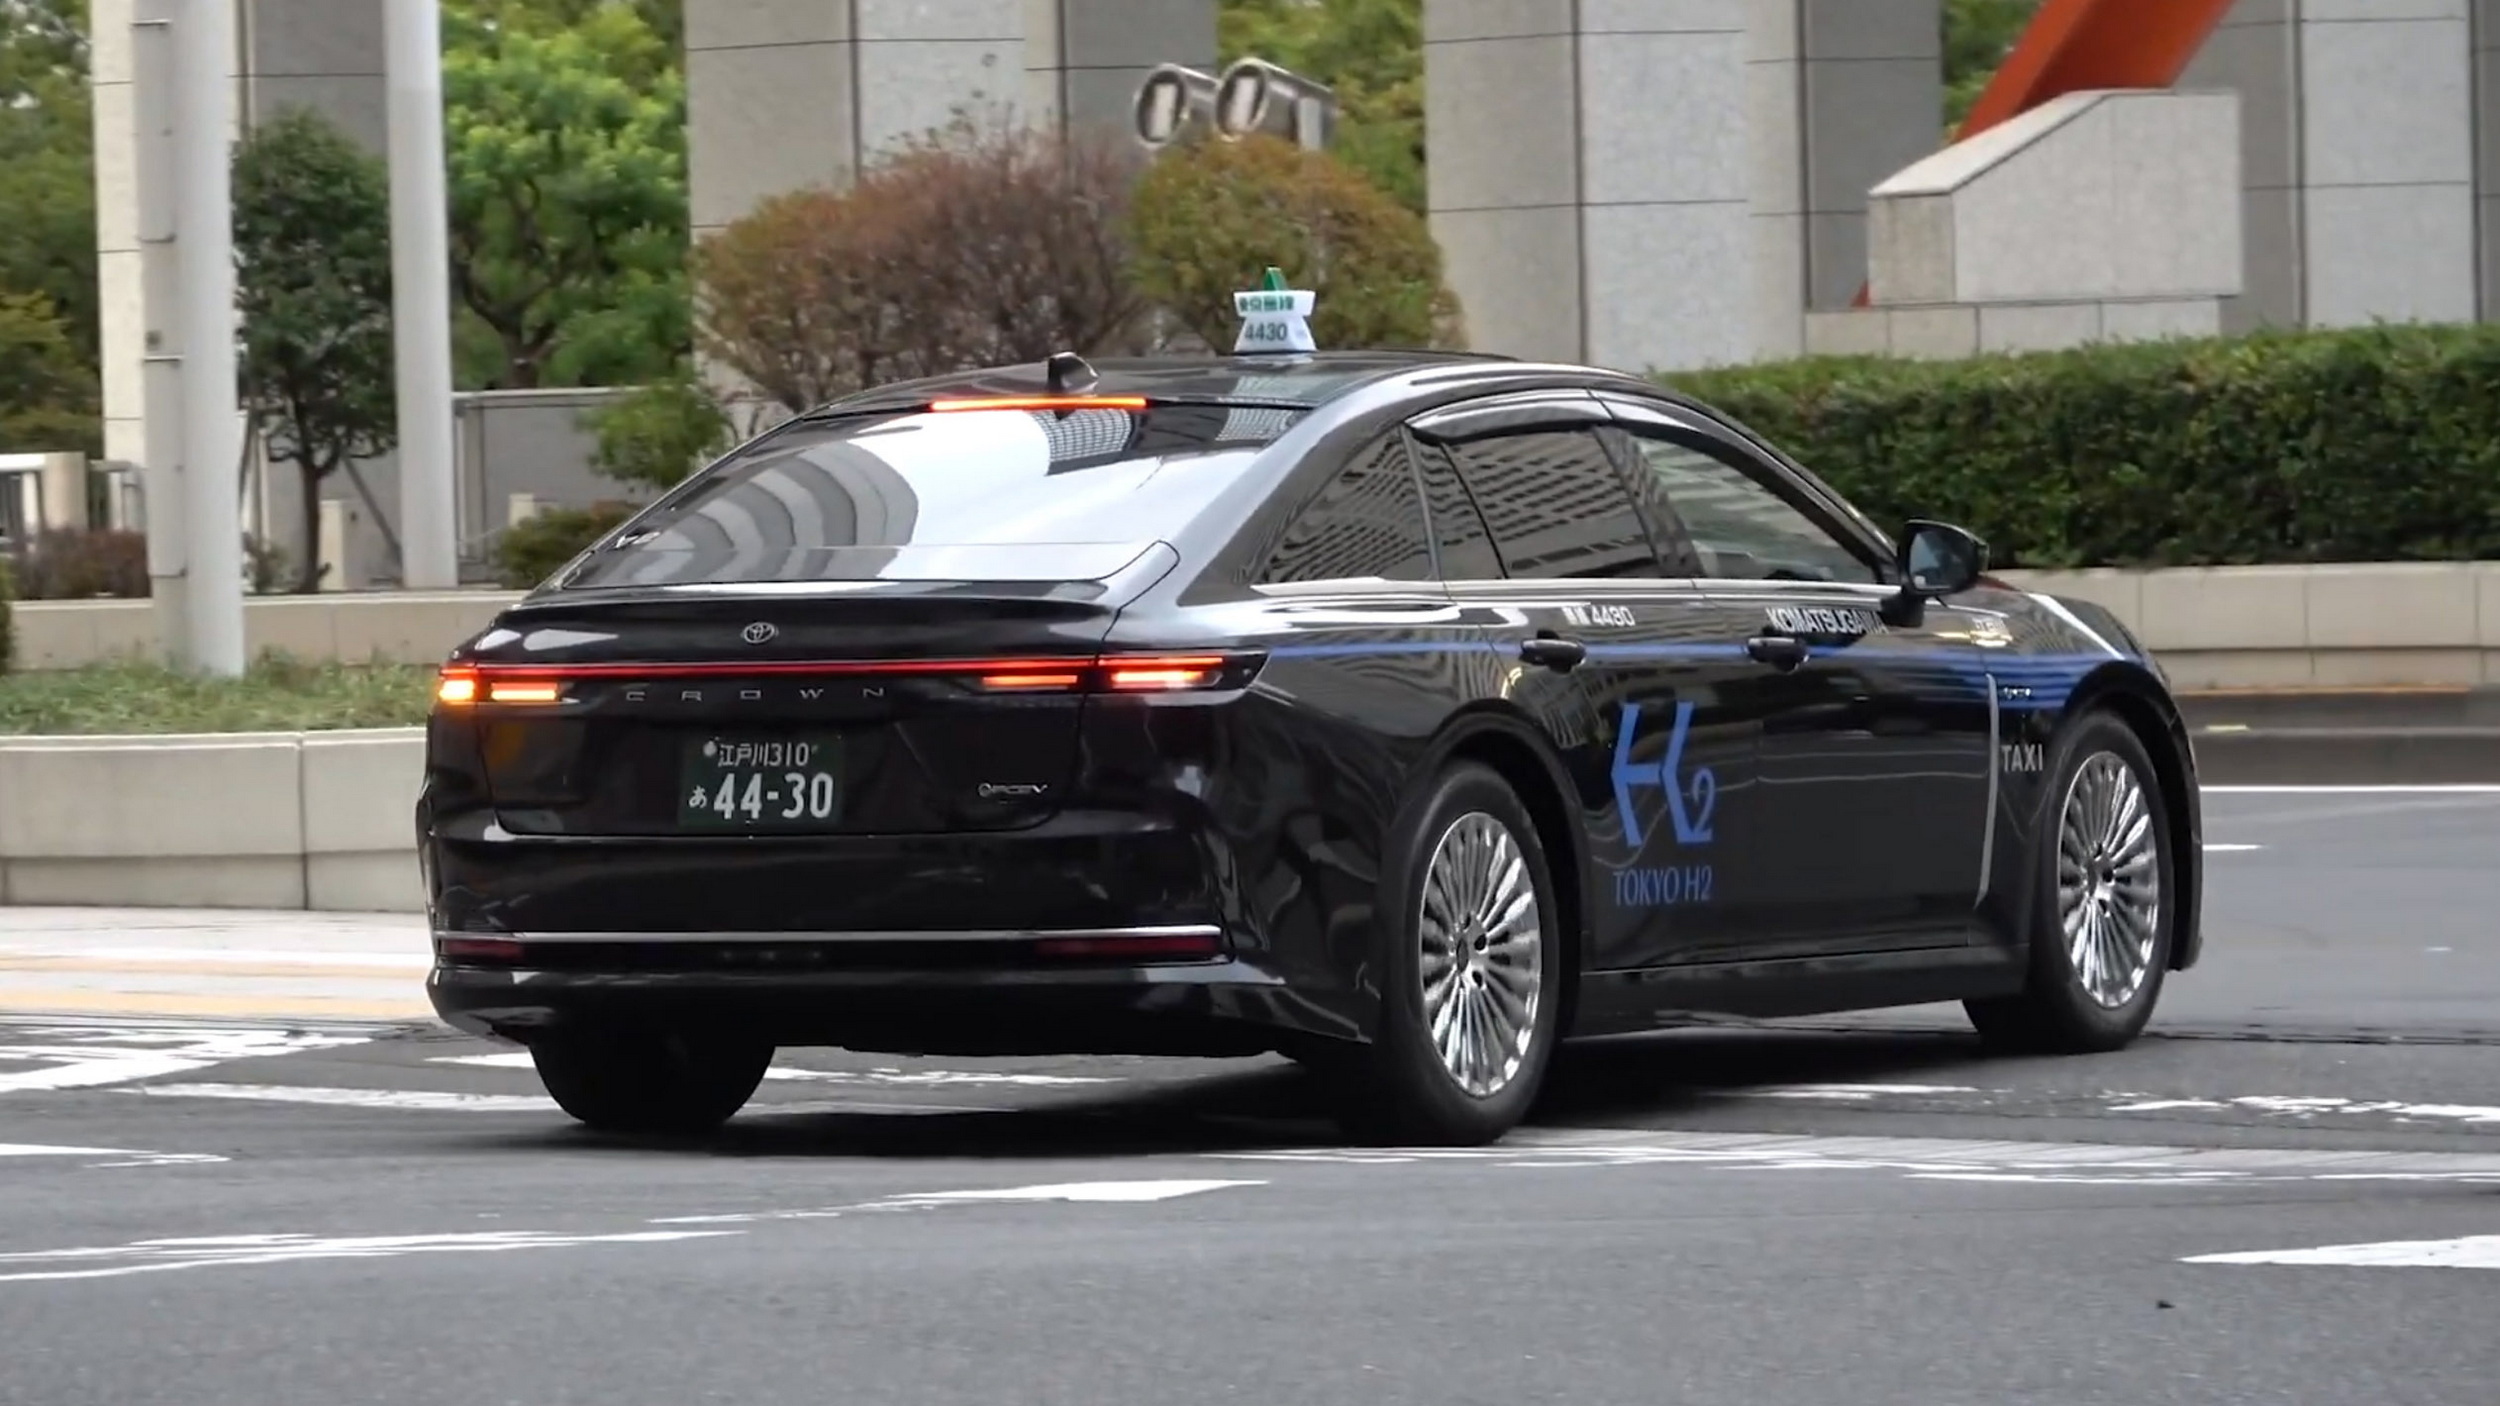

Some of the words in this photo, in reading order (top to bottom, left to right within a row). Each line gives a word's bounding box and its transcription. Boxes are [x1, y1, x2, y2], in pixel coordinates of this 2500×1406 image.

[1244, 323, 1288, 341] 4430
[625, 687, 885, 701] CROWN
[2001, 743, 2043, 773] TAXI
[688, 785, 708, 809] あ
[713, 772, 834, 820] 44-30
[1613, 866, 1680, 907] TOKYO
[1684, 864, 1713, 901] H2
